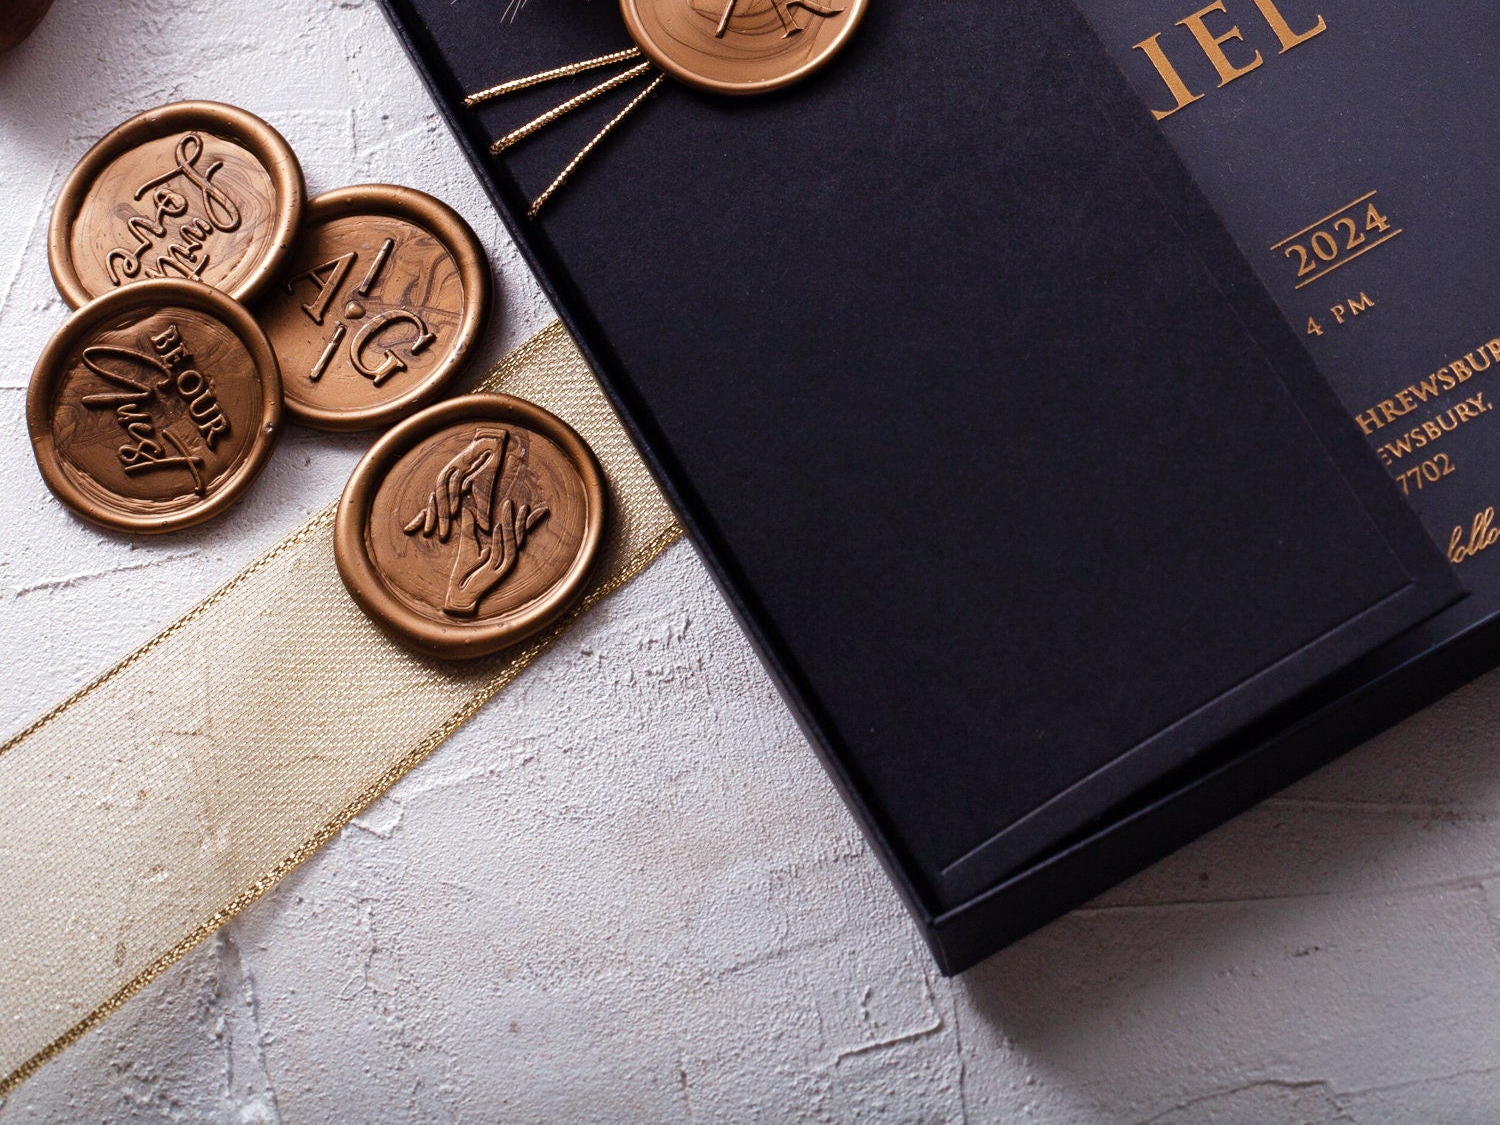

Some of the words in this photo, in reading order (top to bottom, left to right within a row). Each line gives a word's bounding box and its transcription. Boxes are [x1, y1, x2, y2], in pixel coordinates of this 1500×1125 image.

[1284, 203, 1391, 277] 2024
[1305, 316, 1325, 338] 4
[1330, 290, 1376, 324] PM
[149, 324, 188, 369] BE
[177, 369, 231, 451] OUR
[1395, 452, 1456, 497] 7702
